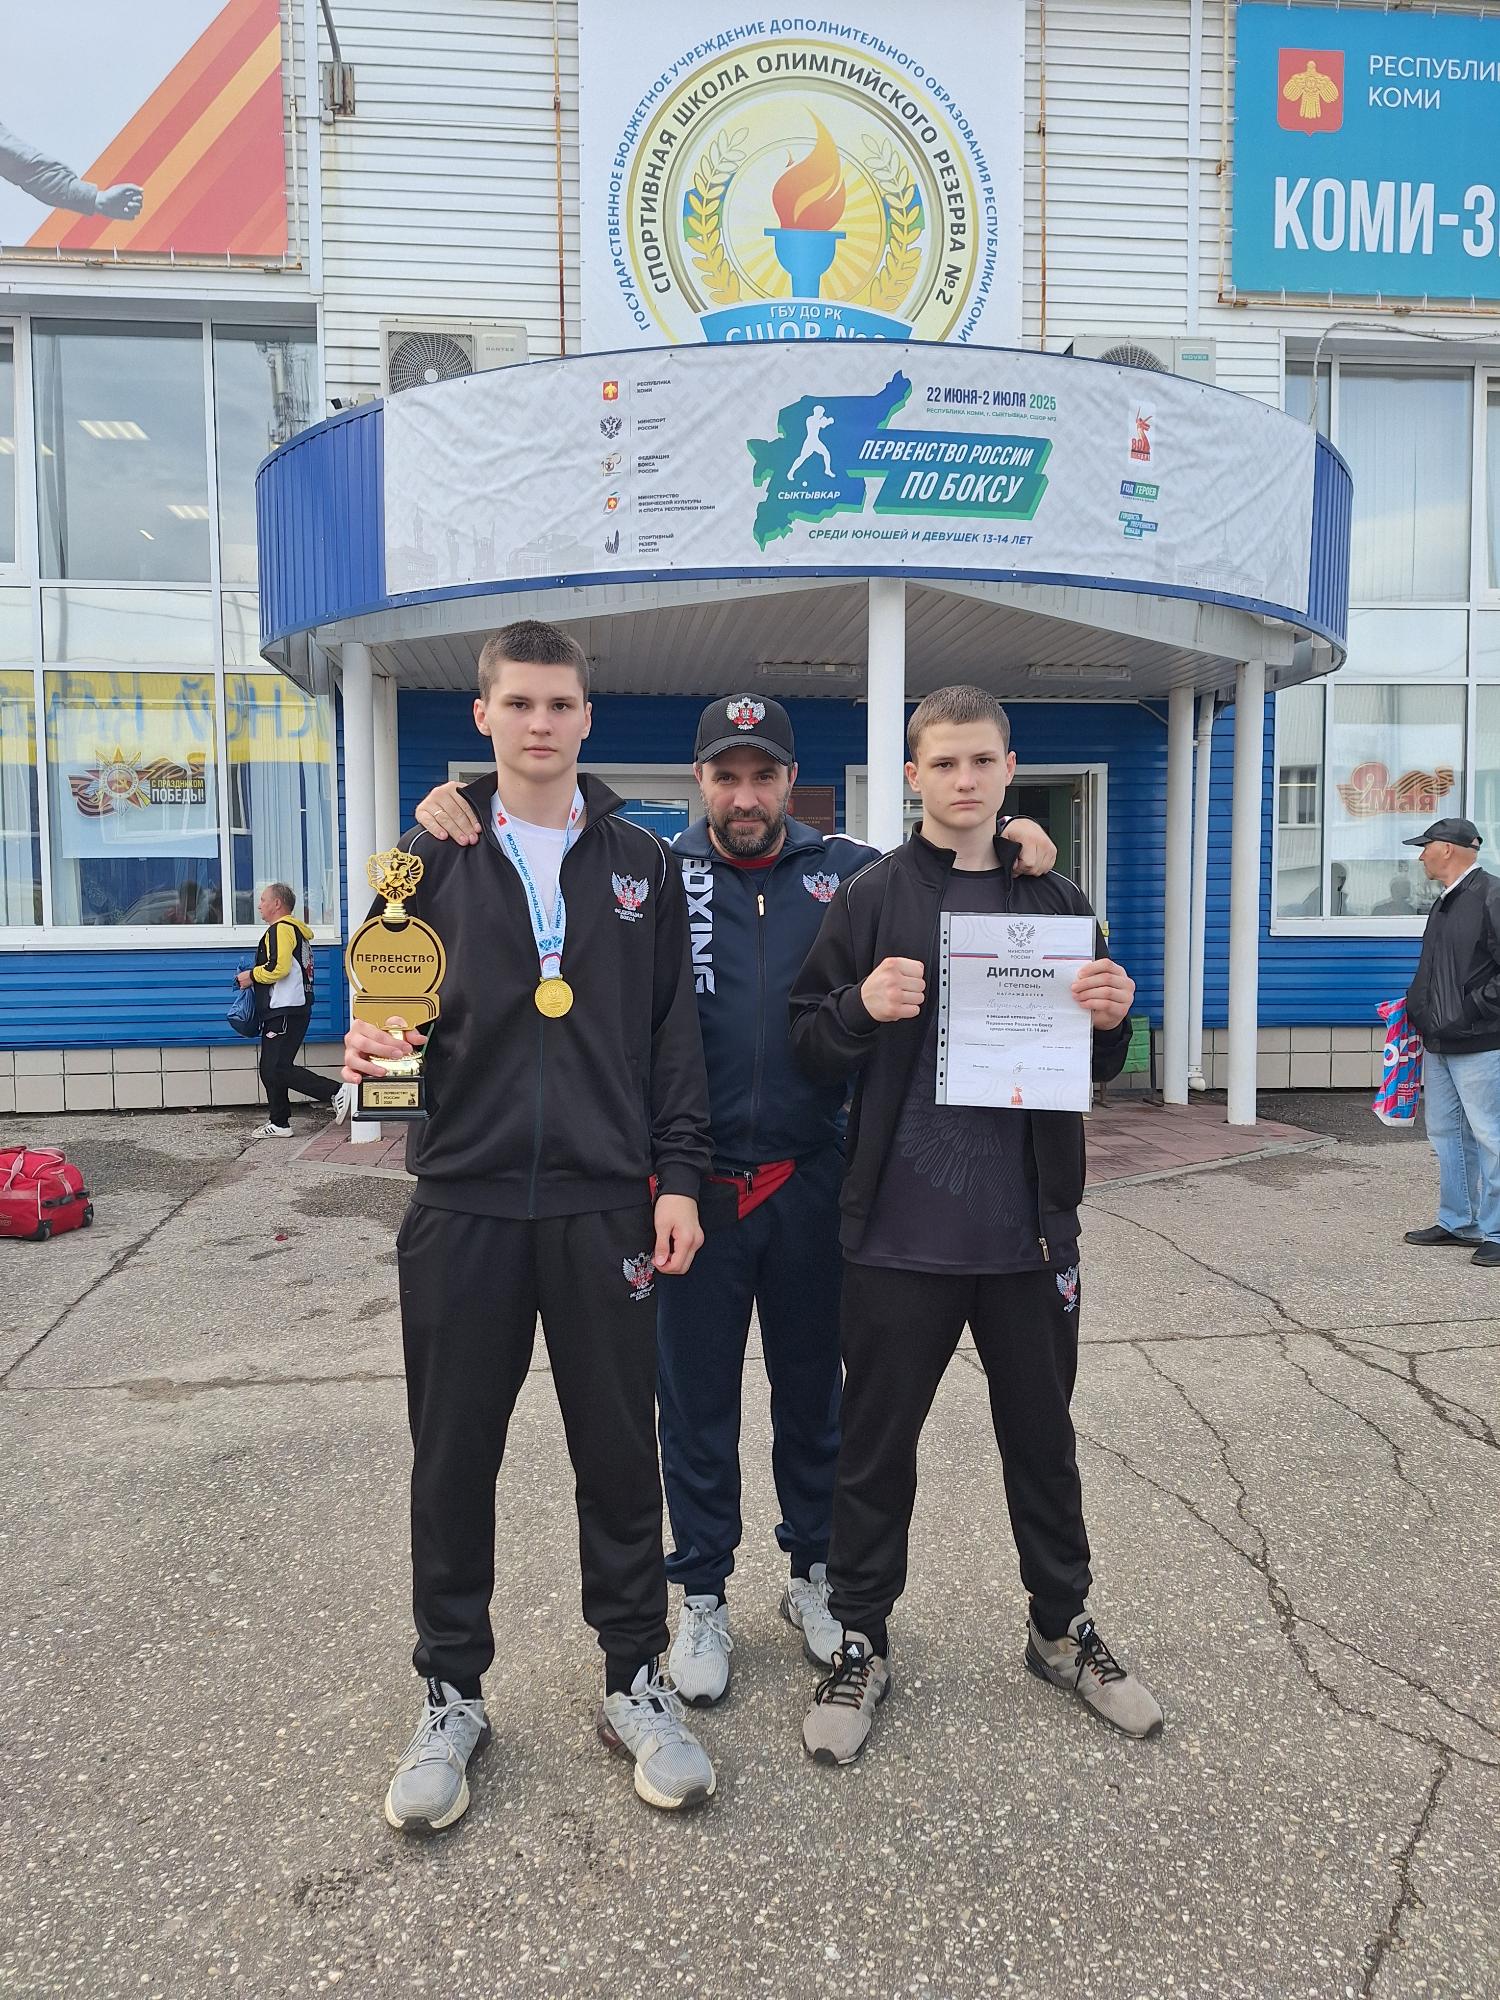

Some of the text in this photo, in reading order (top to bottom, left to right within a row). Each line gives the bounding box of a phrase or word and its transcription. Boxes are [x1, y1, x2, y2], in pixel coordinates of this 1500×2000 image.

[1369, 55, 1500, 82] РЕСПУБЛИ
[1369, 86, 1441, 110] КОМИ
[607, 18, 998, 343] ГОСУДАРСТВЕННОЕ БЮДЖЕТНОЕ УЧРЕЖДЕНИЕ ДОПОЛНИТЕЛЬНОГО ОБРАЗОВАНИЯ РЕСПУБЛИКИ КОМИ
[641, 129, 677, 293] СПОРТИВНАЯ
[672, 64, 750, 127] ШКОЛА
[756, 53, 938, 144] ОЛИМПИЙСКОГО
[933, 149, 966, 252] РЕЗЕРВА
[1274, 176, 1500, 258] КОМИ-З
[770, 306, 842, 321] ГБУ ДО РК
[926, 386, 941, 403] 22
[993, 391, 1026, 408] ИЮЛЯ
[1029, 394, 1057, 411] 2025
[858, 439, 1035, 468] ПЕРВЕНСТВО РОССИИ
[777, 490, 841, 501] СЫКТЫВКАР
[899, 471, 1025, 505] ПО БОКСУ
[808, 528, 1033, 545] СРЕДИ ЮНОШЕЙ И ДЕВУШЕК 13-14 ЛЕТ
[151, 780, 204, 788] С ПРАЗДНИКОМ
[152, 788, 204, 804] ПОБЕДЫ!
[356, 953, 435, 964] ПЕРВЕНСТВО
[370, 965, 422, 975] РОССИИ
[986, 967, 1055, 979] ДИПЛОМ
